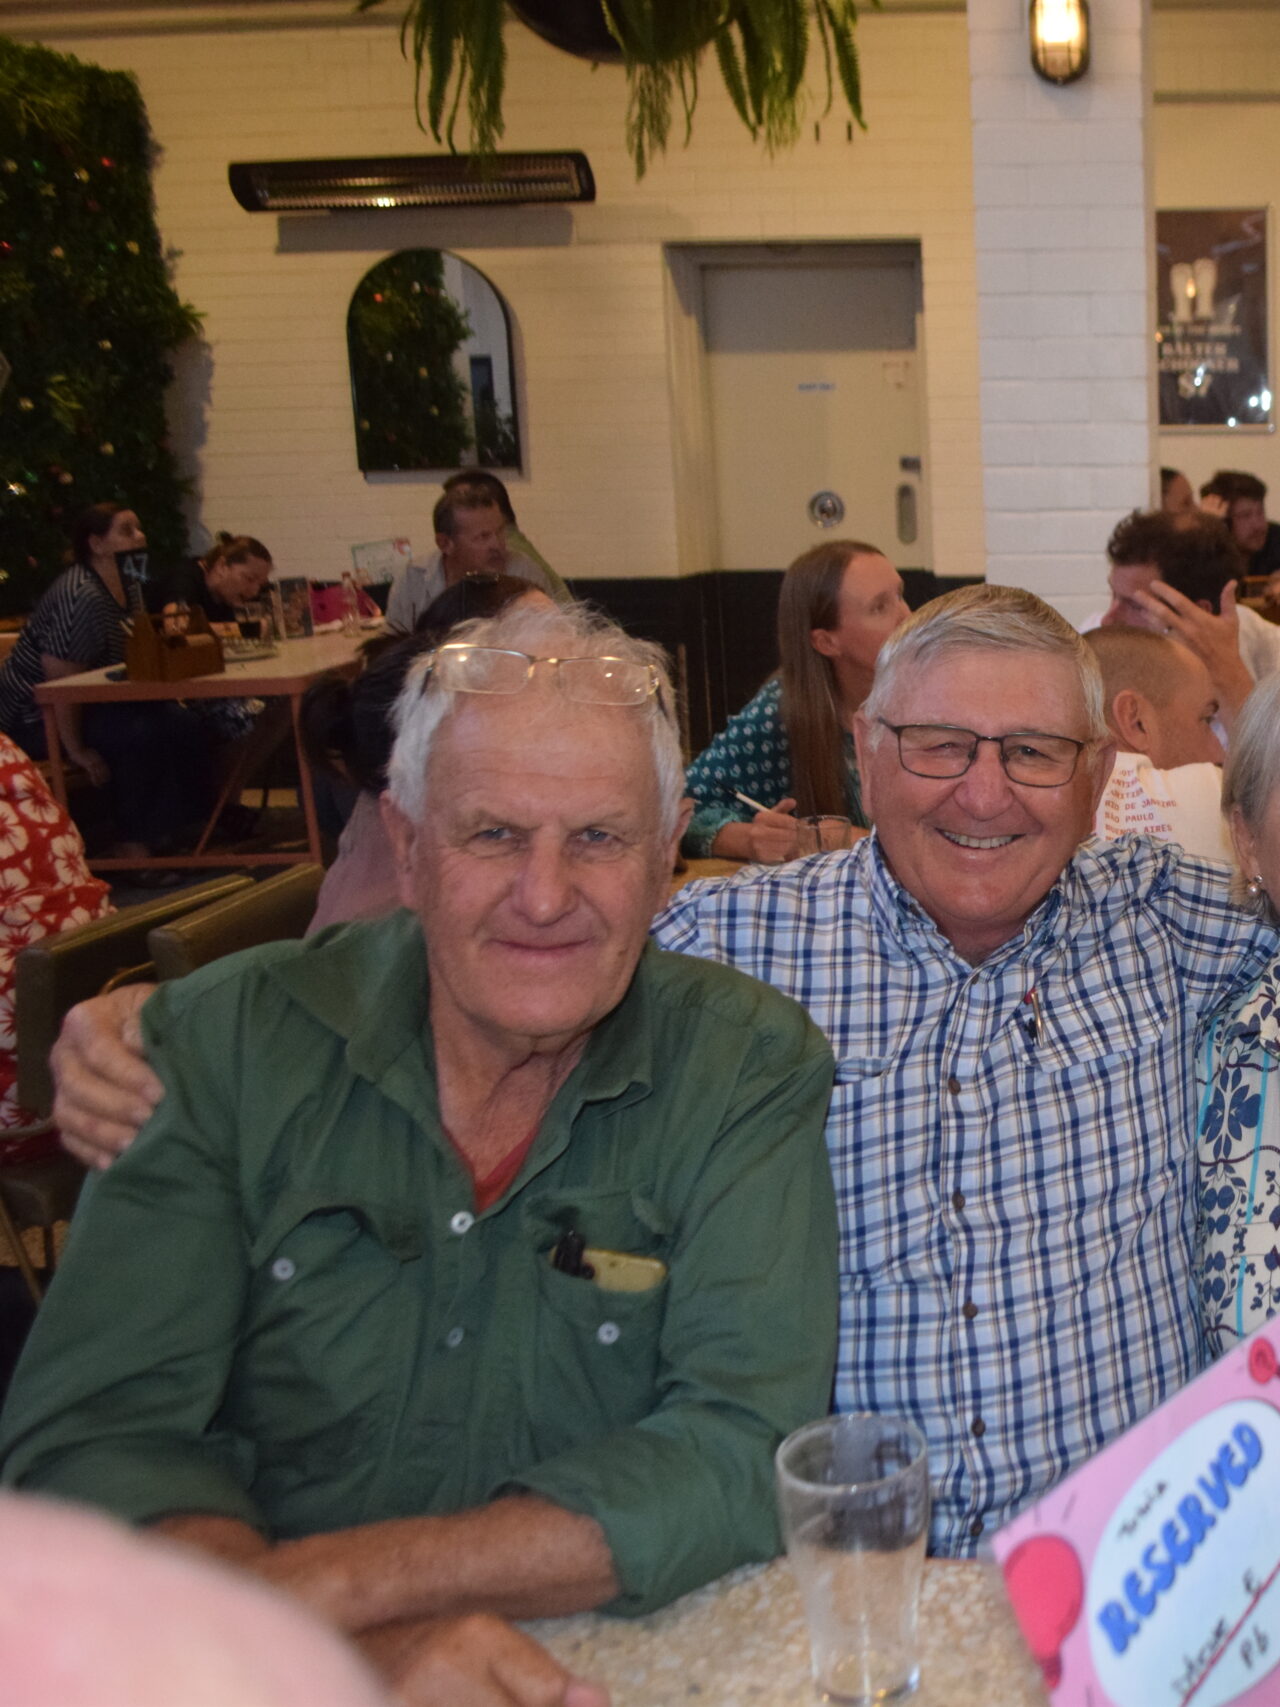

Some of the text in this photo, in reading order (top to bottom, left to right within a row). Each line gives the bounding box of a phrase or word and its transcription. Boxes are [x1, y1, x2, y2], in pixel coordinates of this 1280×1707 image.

[1125, 802, 1136, 810] DE
[1125, 812, 1154, 823] PAULO
[1144, 824, 1173, 833] AIRES
[1097, 1421, 1262, 1657] RESERVED
